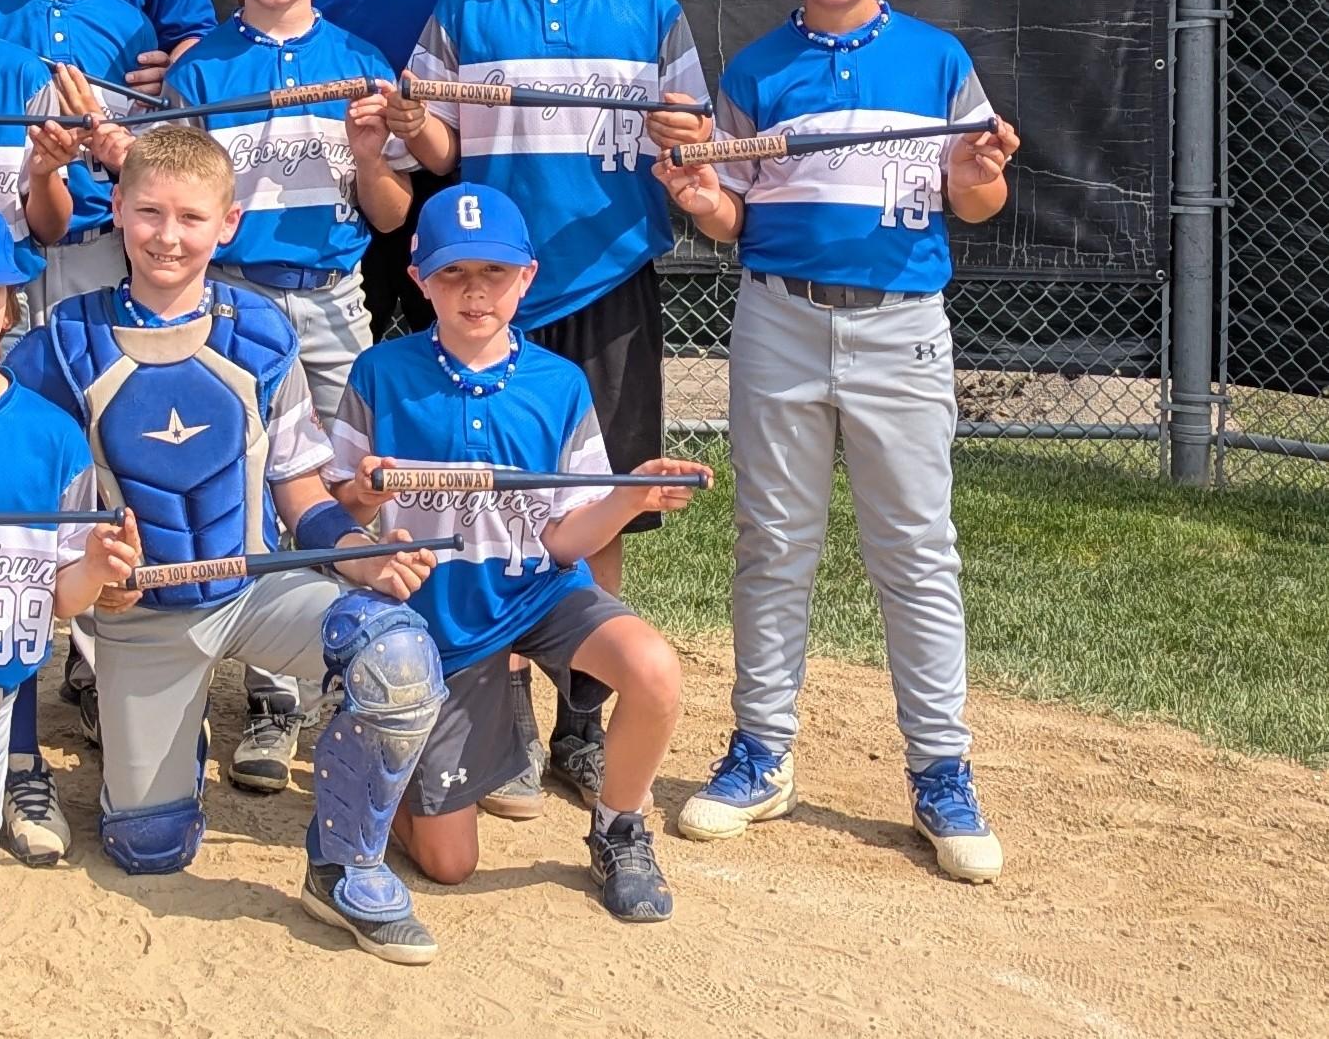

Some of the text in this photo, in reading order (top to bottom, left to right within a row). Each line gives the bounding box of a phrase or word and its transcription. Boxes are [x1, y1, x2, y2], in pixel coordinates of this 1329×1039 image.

[412, 81, 509, 102] 2025 10U CONWAY
[587, 107, 644, 172] 43
[684, 137, 782, 158] 2025 10U CONWAY
[879, 160, 934, 230] 13
[457, 195, 481, 230] G
[386, 472, 491, 489] 2025 10U CONWAY
[138, 560, 244, 585] 2025 10U CONWAY
